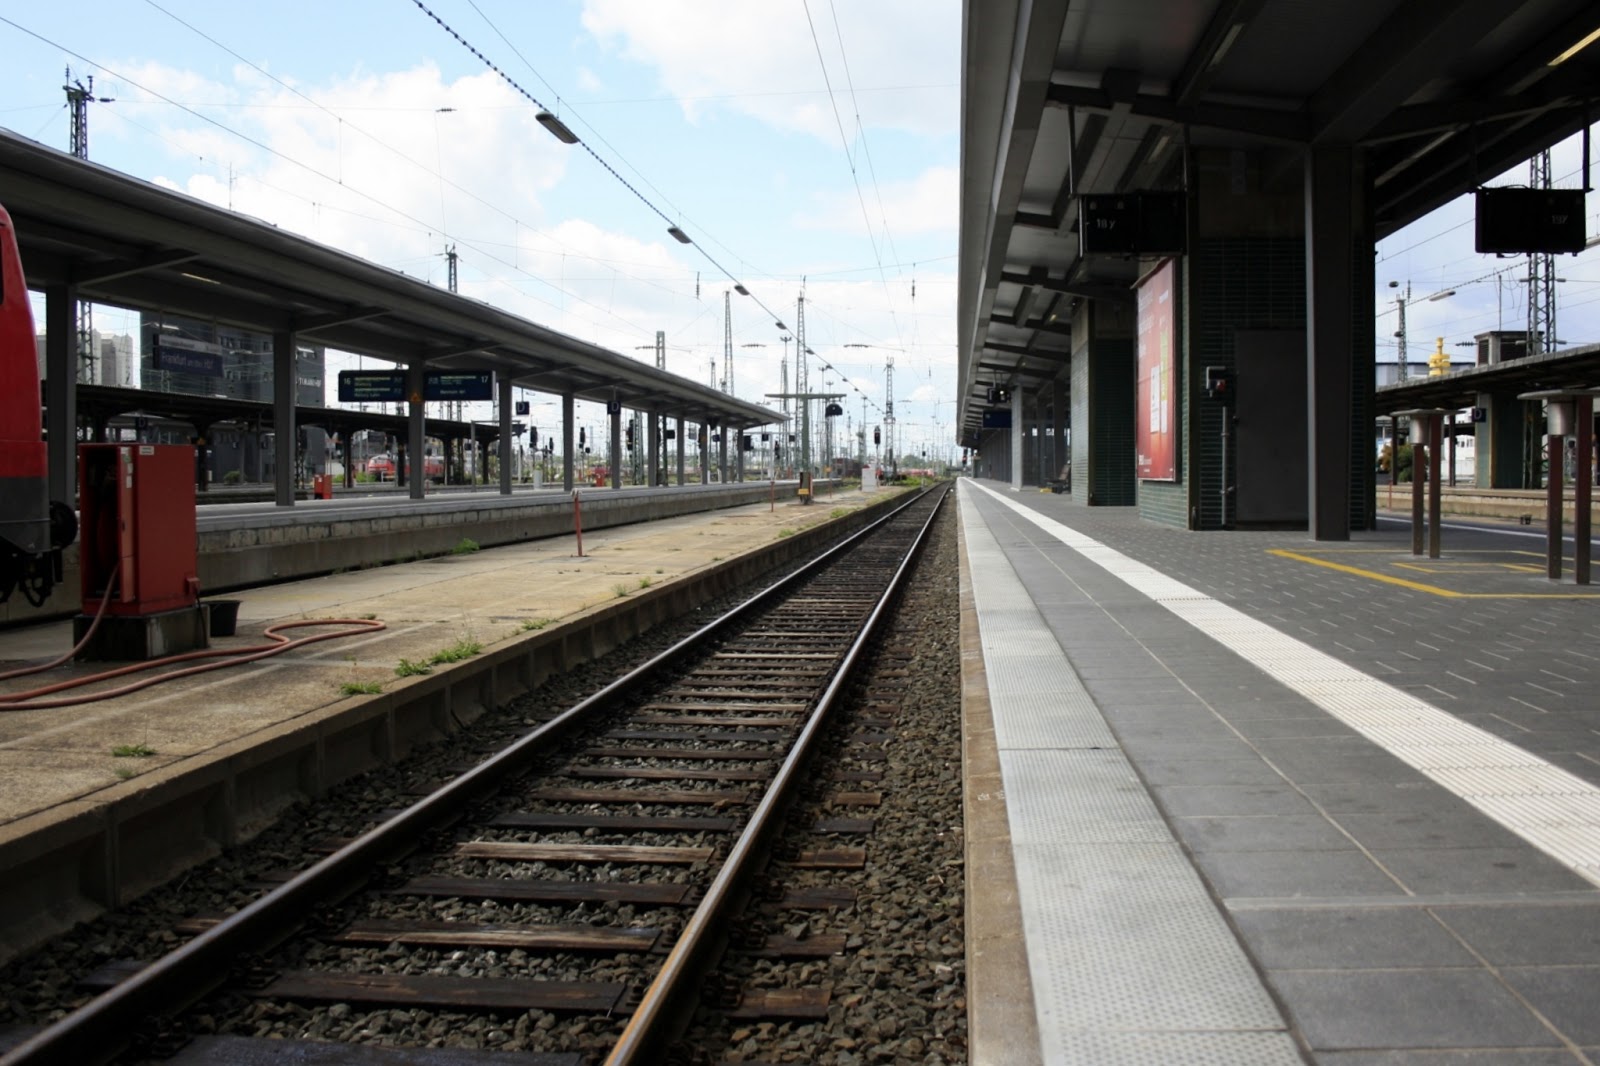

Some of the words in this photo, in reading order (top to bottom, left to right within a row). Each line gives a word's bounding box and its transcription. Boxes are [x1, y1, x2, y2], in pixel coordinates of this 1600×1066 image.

[343, 377, 351, 386] 16
[480, 375, 489, 384] 17
[516, 402, 525, 412] D
[611, 401, 619, 412] D
[1473, 409, 1482, 420] D
